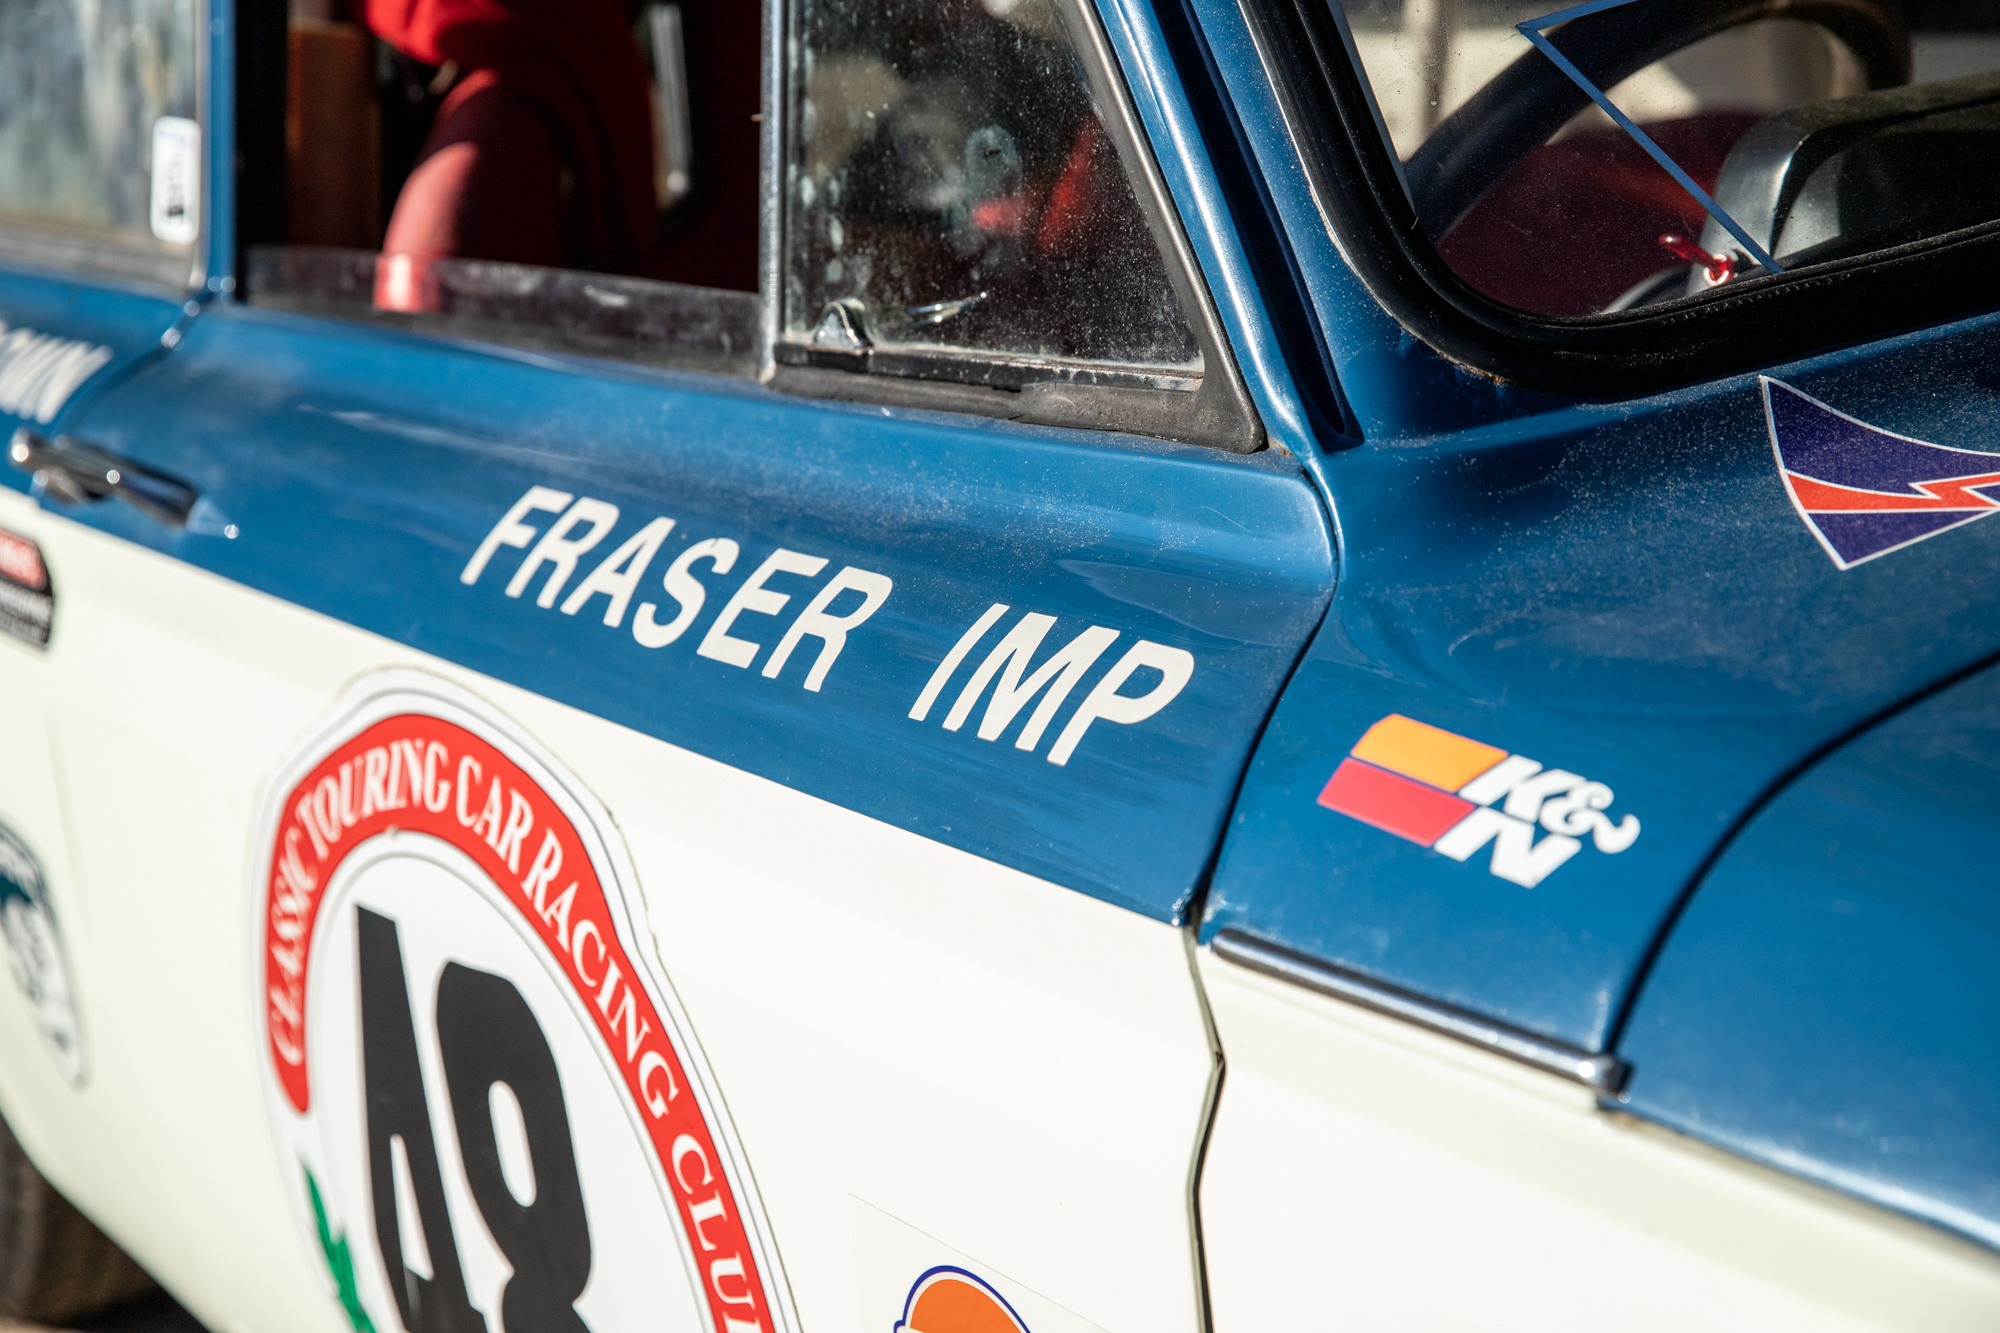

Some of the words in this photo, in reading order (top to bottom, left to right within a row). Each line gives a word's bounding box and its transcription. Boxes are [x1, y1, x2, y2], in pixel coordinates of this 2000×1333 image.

[460, 485, 893, 692] FRASER
[908, 603, 1195, 767] IMP
[270, 826, 318, 1066] CLASSIC
[295, 738, 452, 861] TOURING
[456, 754, 534, 875] CAR
[520, 827, 680, 1119] RACING
